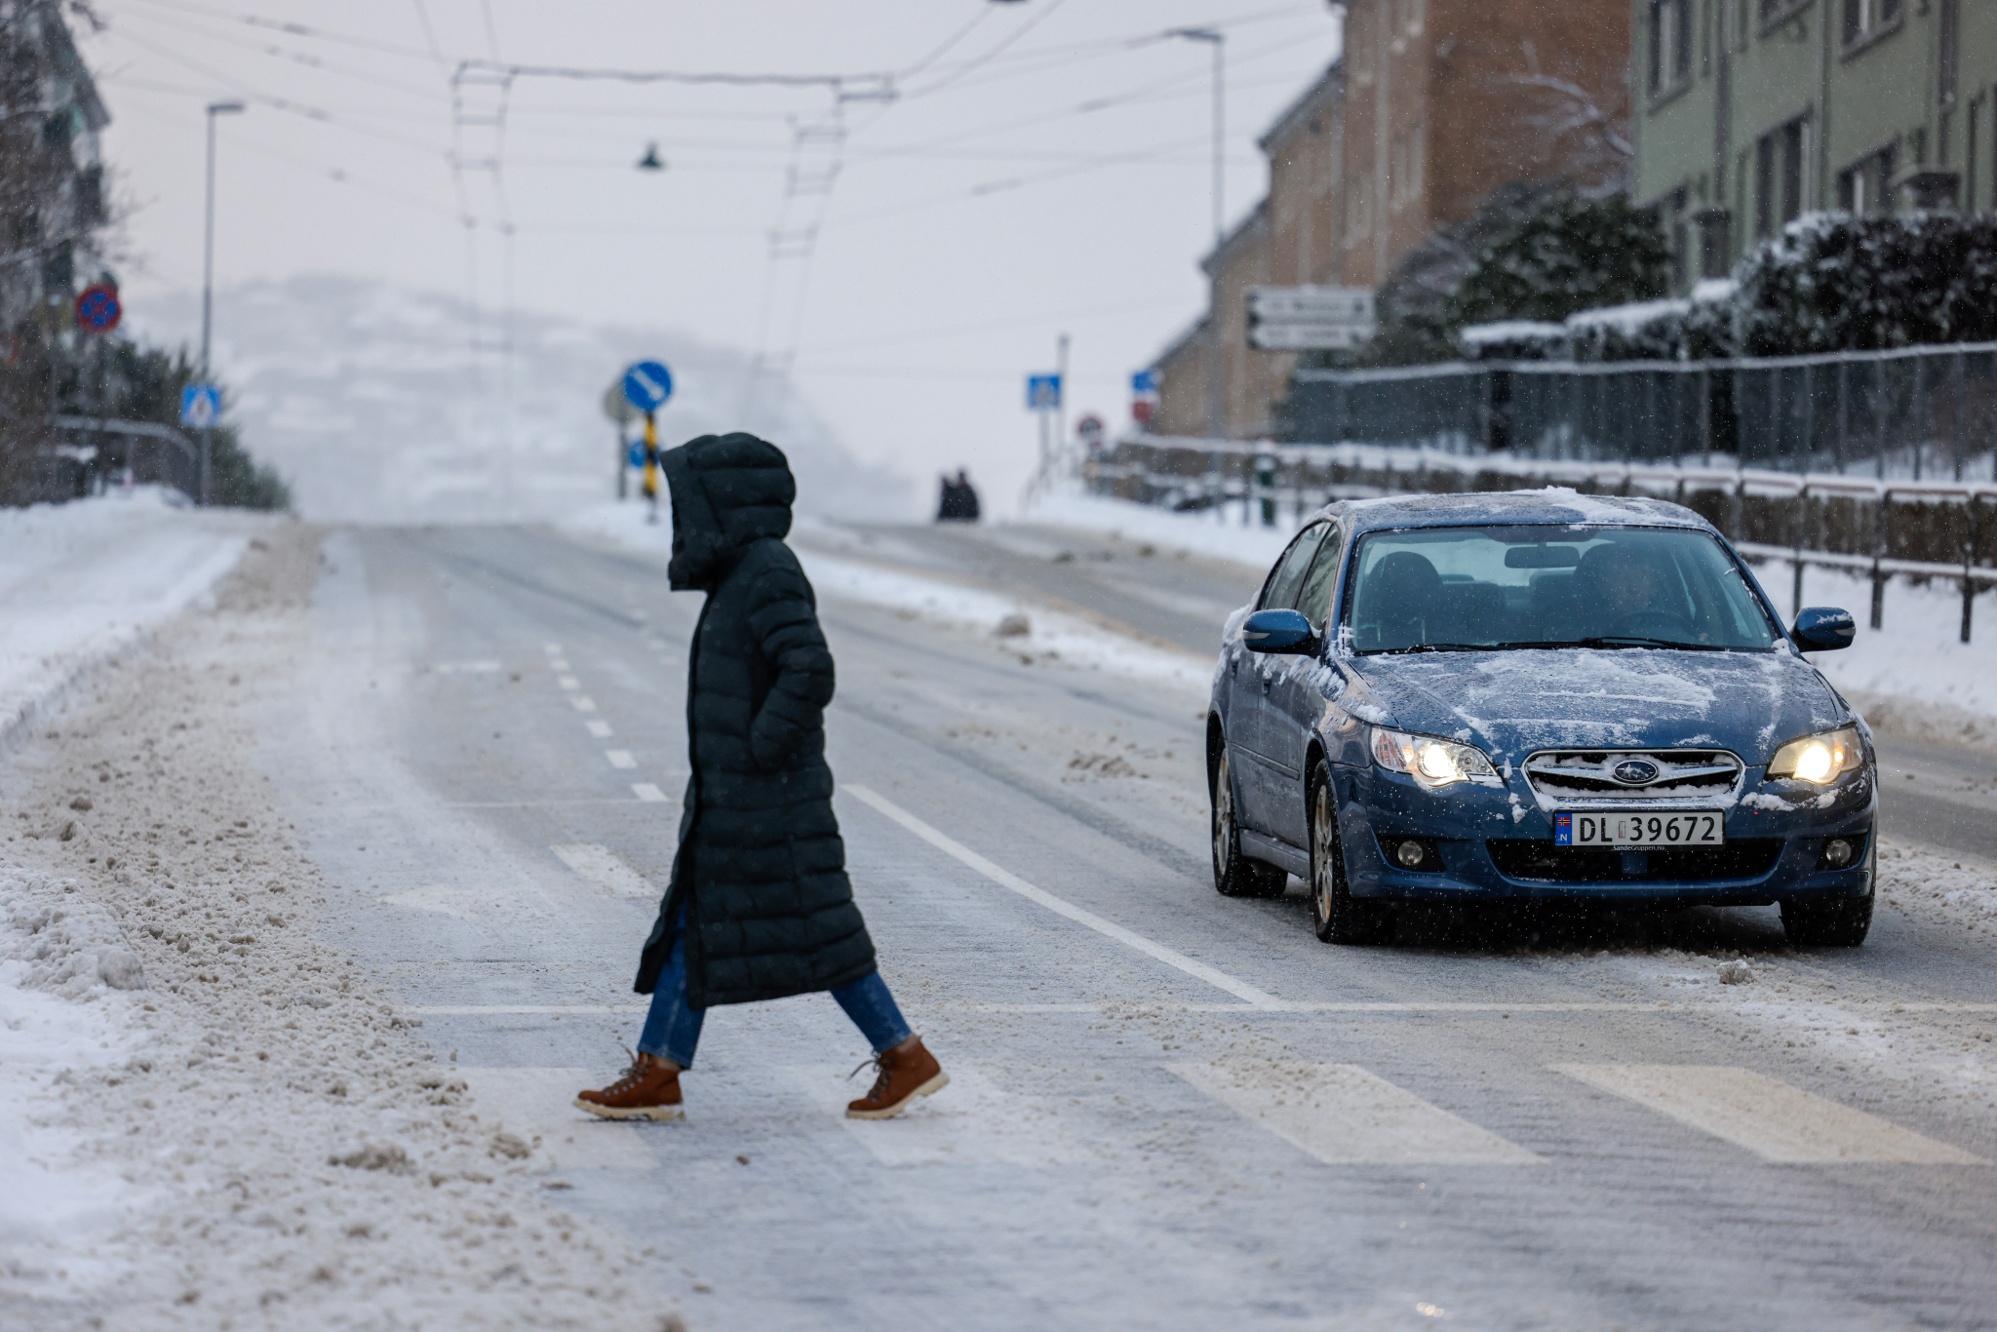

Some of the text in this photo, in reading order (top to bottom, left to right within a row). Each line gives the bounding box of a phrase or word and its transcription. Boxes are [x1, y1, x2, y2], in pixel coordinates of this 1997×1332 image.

[1559, 833, 1568, 842] N
[1579, 816, 1715, 842] DL 39672
